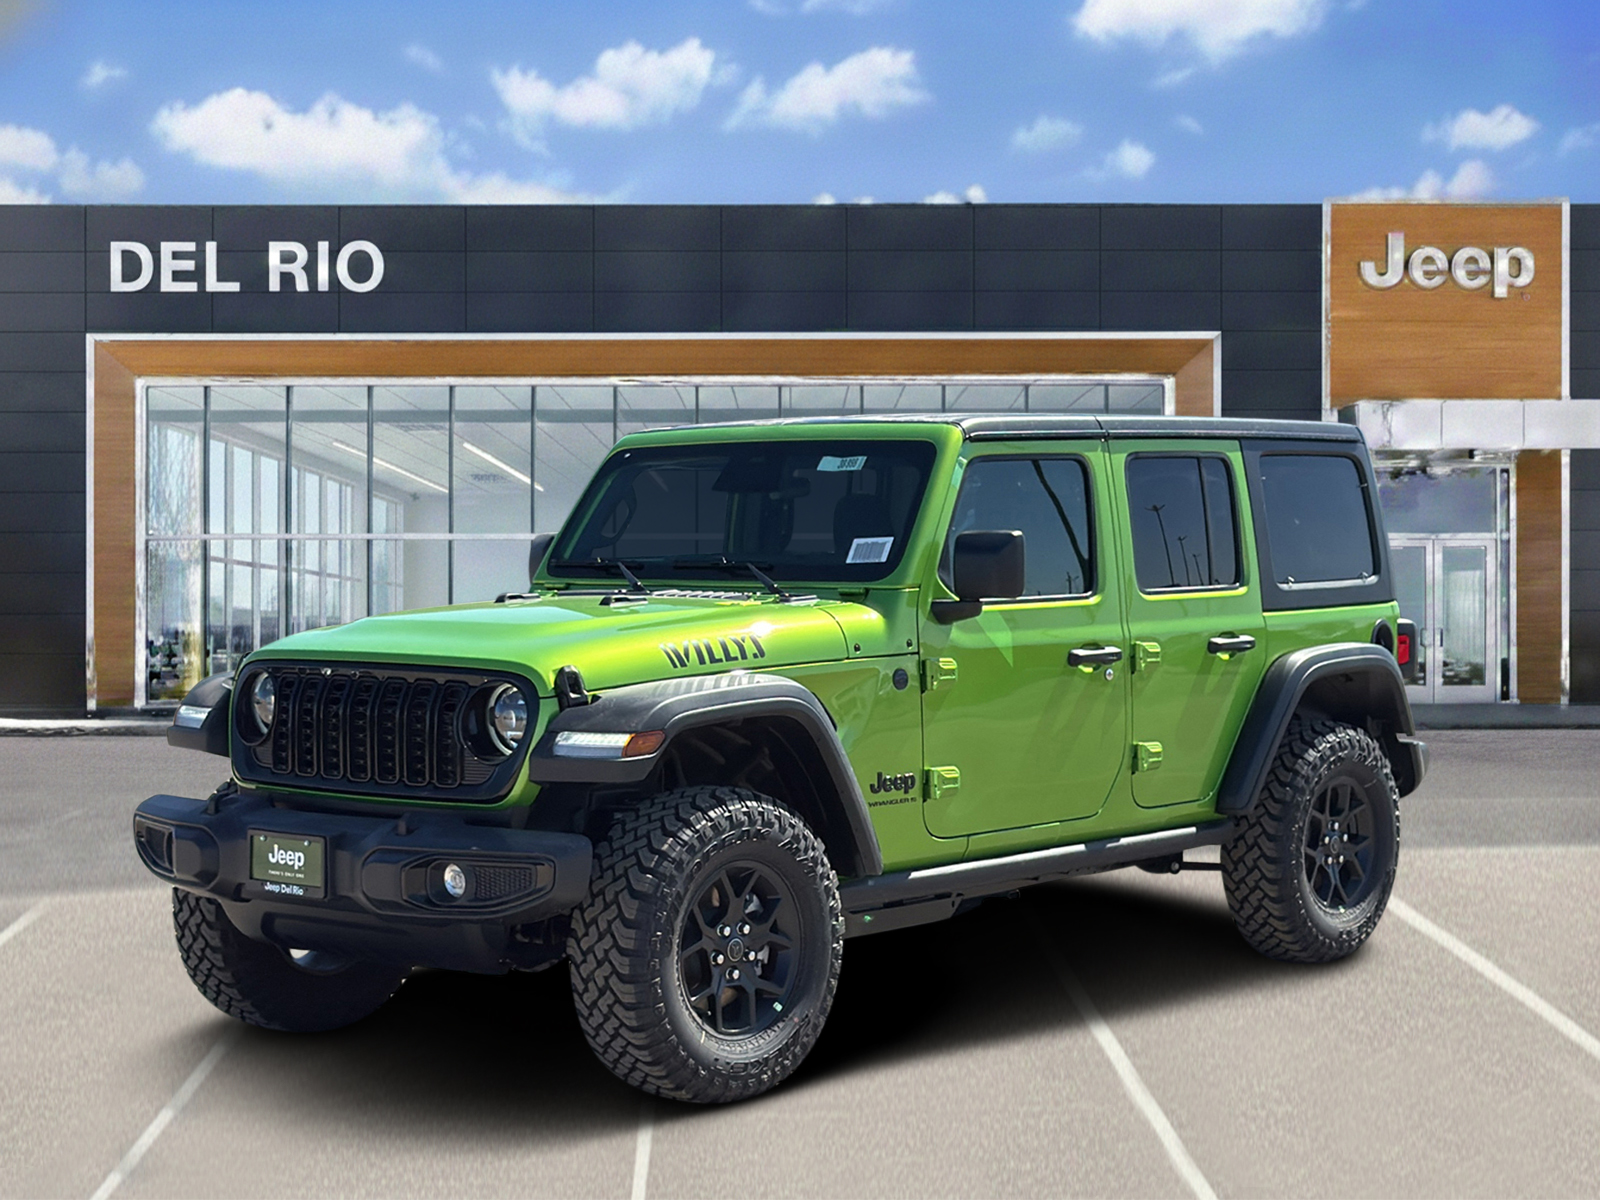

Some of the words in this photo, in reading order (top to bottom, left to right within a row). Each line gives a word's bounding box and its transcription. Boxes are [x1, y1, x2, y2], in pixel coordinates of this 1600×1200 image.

[110, 241, 240, 293] DEL
[269, 240, 384, 293] RIO
[1359, 231, 1535, 299] Jeep
[869, 771, 916, 794] Jeep
[868, 798, 909, 807] WRANGLER
[268, 843, 305, 869] Jeep
[264, 881, 280, 893] Jeep
[281, 883, 292, 894] Del
[292, 885, 304, 896] Rio
